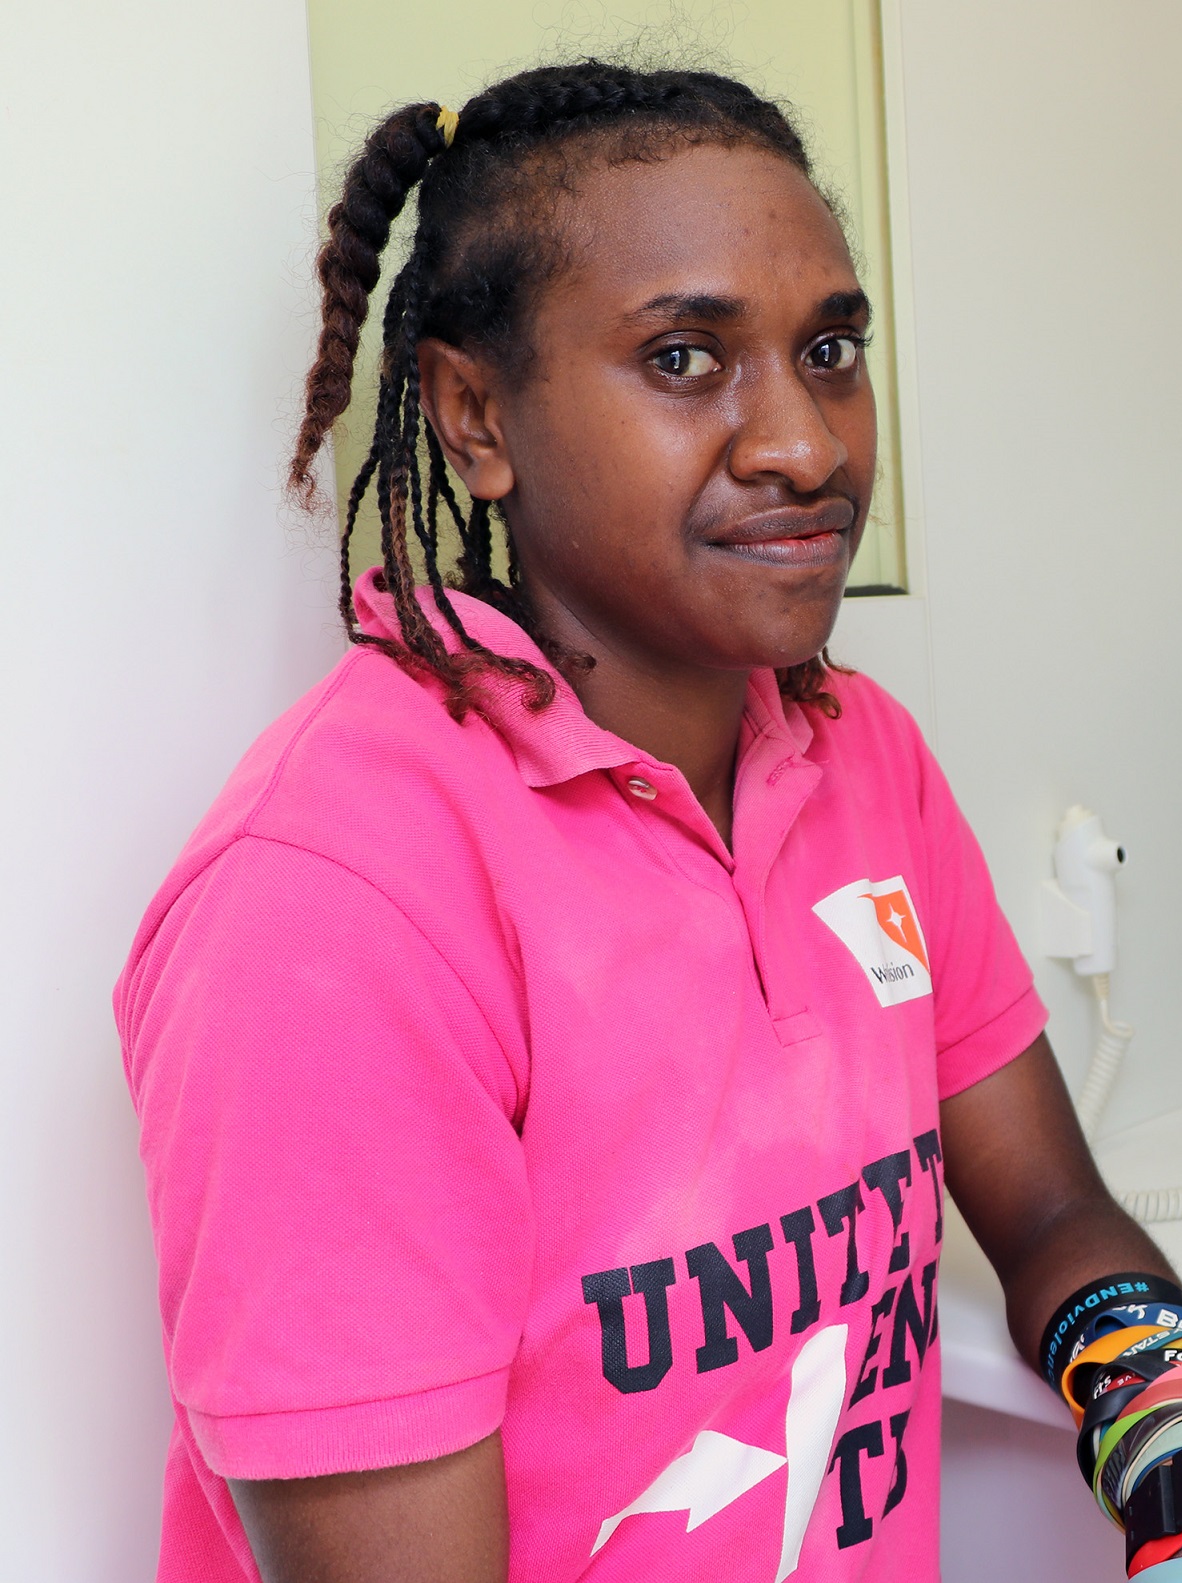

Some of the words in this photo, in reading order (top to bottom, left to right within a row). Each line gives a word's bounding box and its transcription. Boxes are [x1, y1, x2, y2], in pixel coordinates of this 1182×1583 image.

[581, 1148, 912, 1395] UNITE
[913, 1127, 944, 1245] T
[848, 1259, 940, 1411] EN
